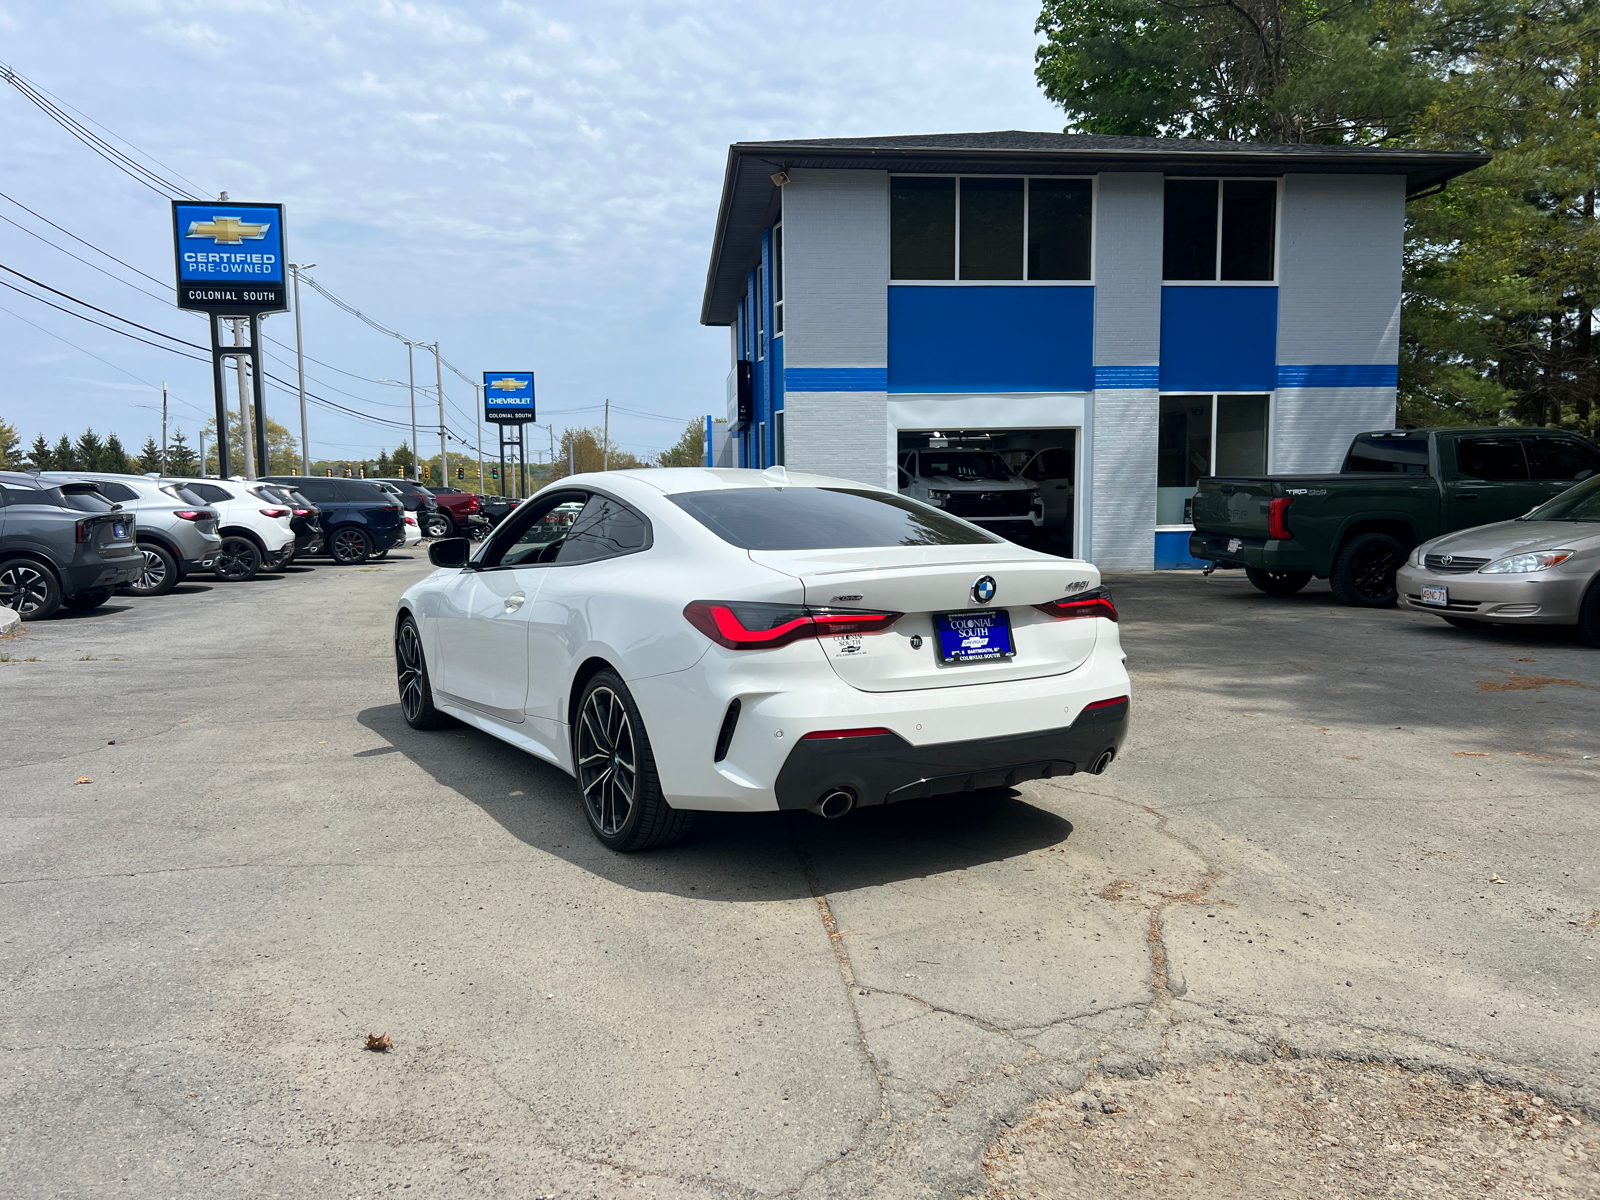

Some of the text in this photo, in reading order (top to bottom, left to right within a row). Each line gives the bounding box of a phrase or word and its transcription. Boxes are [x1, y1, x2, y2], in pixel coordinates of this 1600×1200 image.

[184, 252, 276, 264] CERTIFIED
[189, 263, 272, 273] PRE-OWNED
[188, 290, 275, 301] COLONIAL SOUTH
[1285, 488, 1308, 496] TRD
[1205, 507, 1249, 520] TUNDRA
[950, 618, 994, 630] COLONIAL
[958, 627, 989, 638] SOUTH
[839, 639, 861, 647] SOUTH
